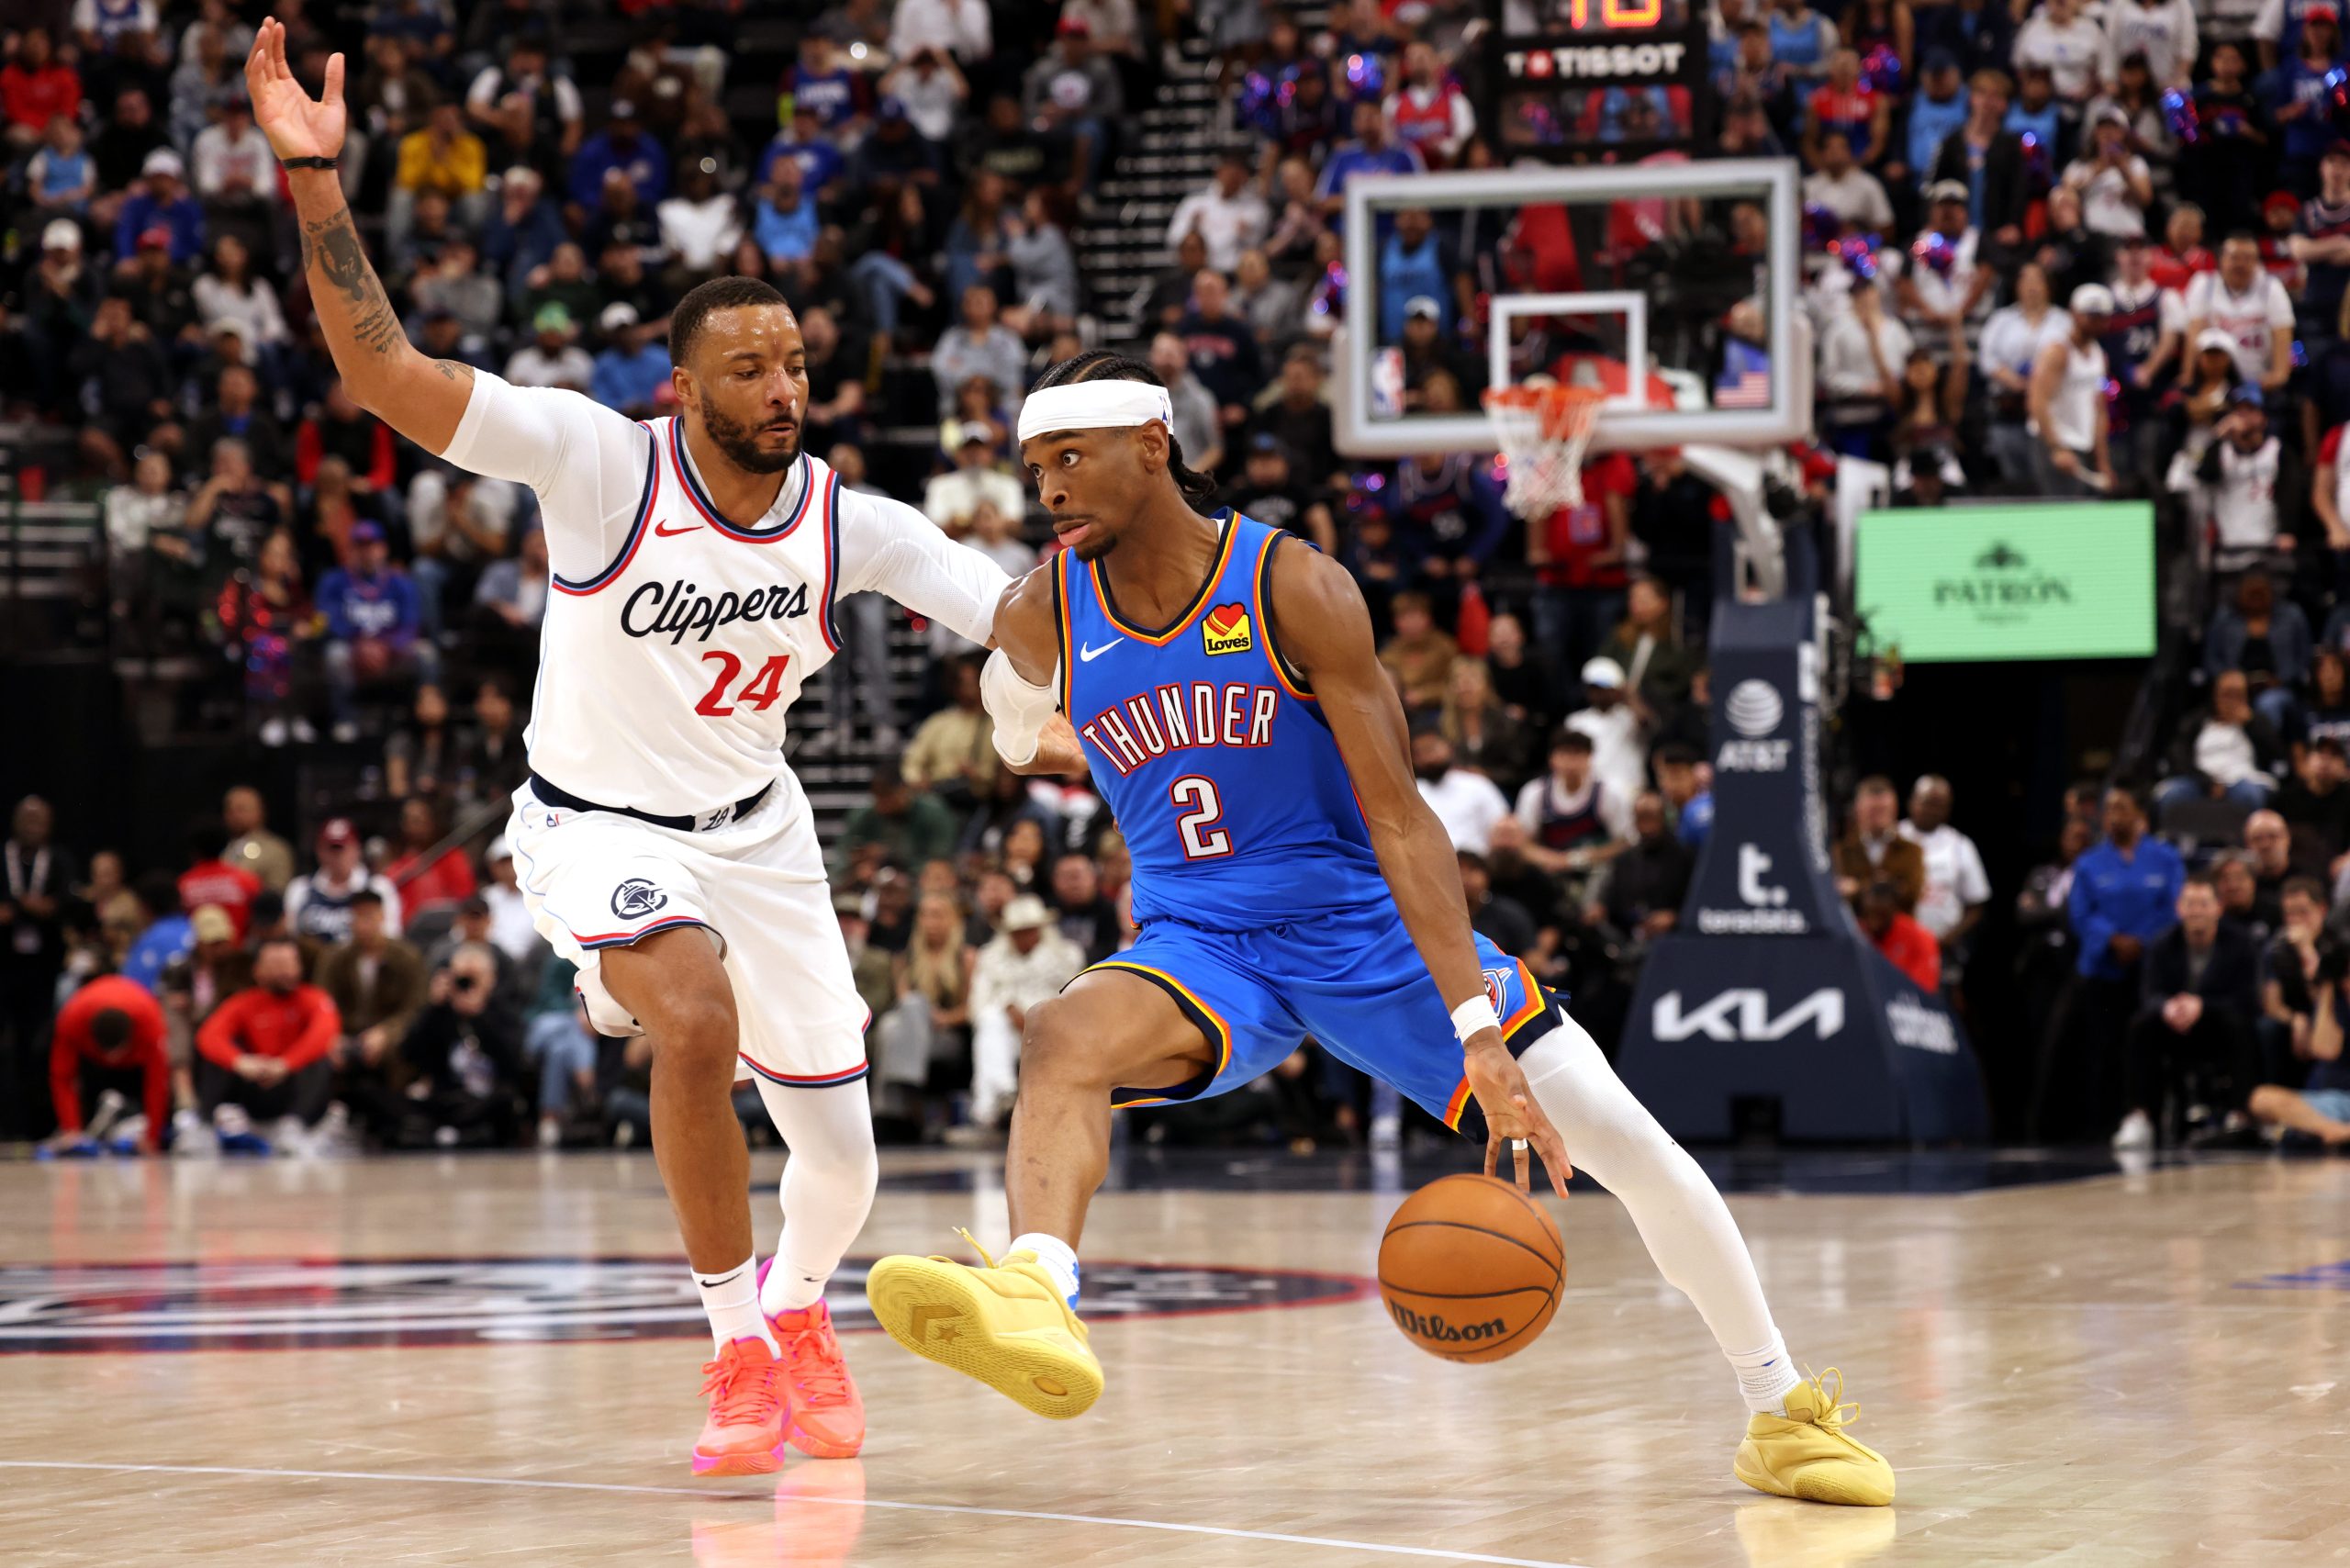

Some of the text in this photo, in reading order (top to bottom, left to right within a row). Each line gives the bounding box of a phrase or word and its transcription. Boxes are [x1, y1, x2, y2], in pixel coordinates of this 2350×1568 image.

[1553, 43, 1685, 78] TISSOT
[621, 579, 810, 645] Clippers
[694, 651, 789, 717] 24
[1079, 680, 1280, 778] THUNDER
[1716, 738, 1793, 772] AT&T
[1169, 773, 1235, 861] 2
[1651, 987, 1845, 1043] KIA
[1388, 1295, 1508, 1341] Wilson
